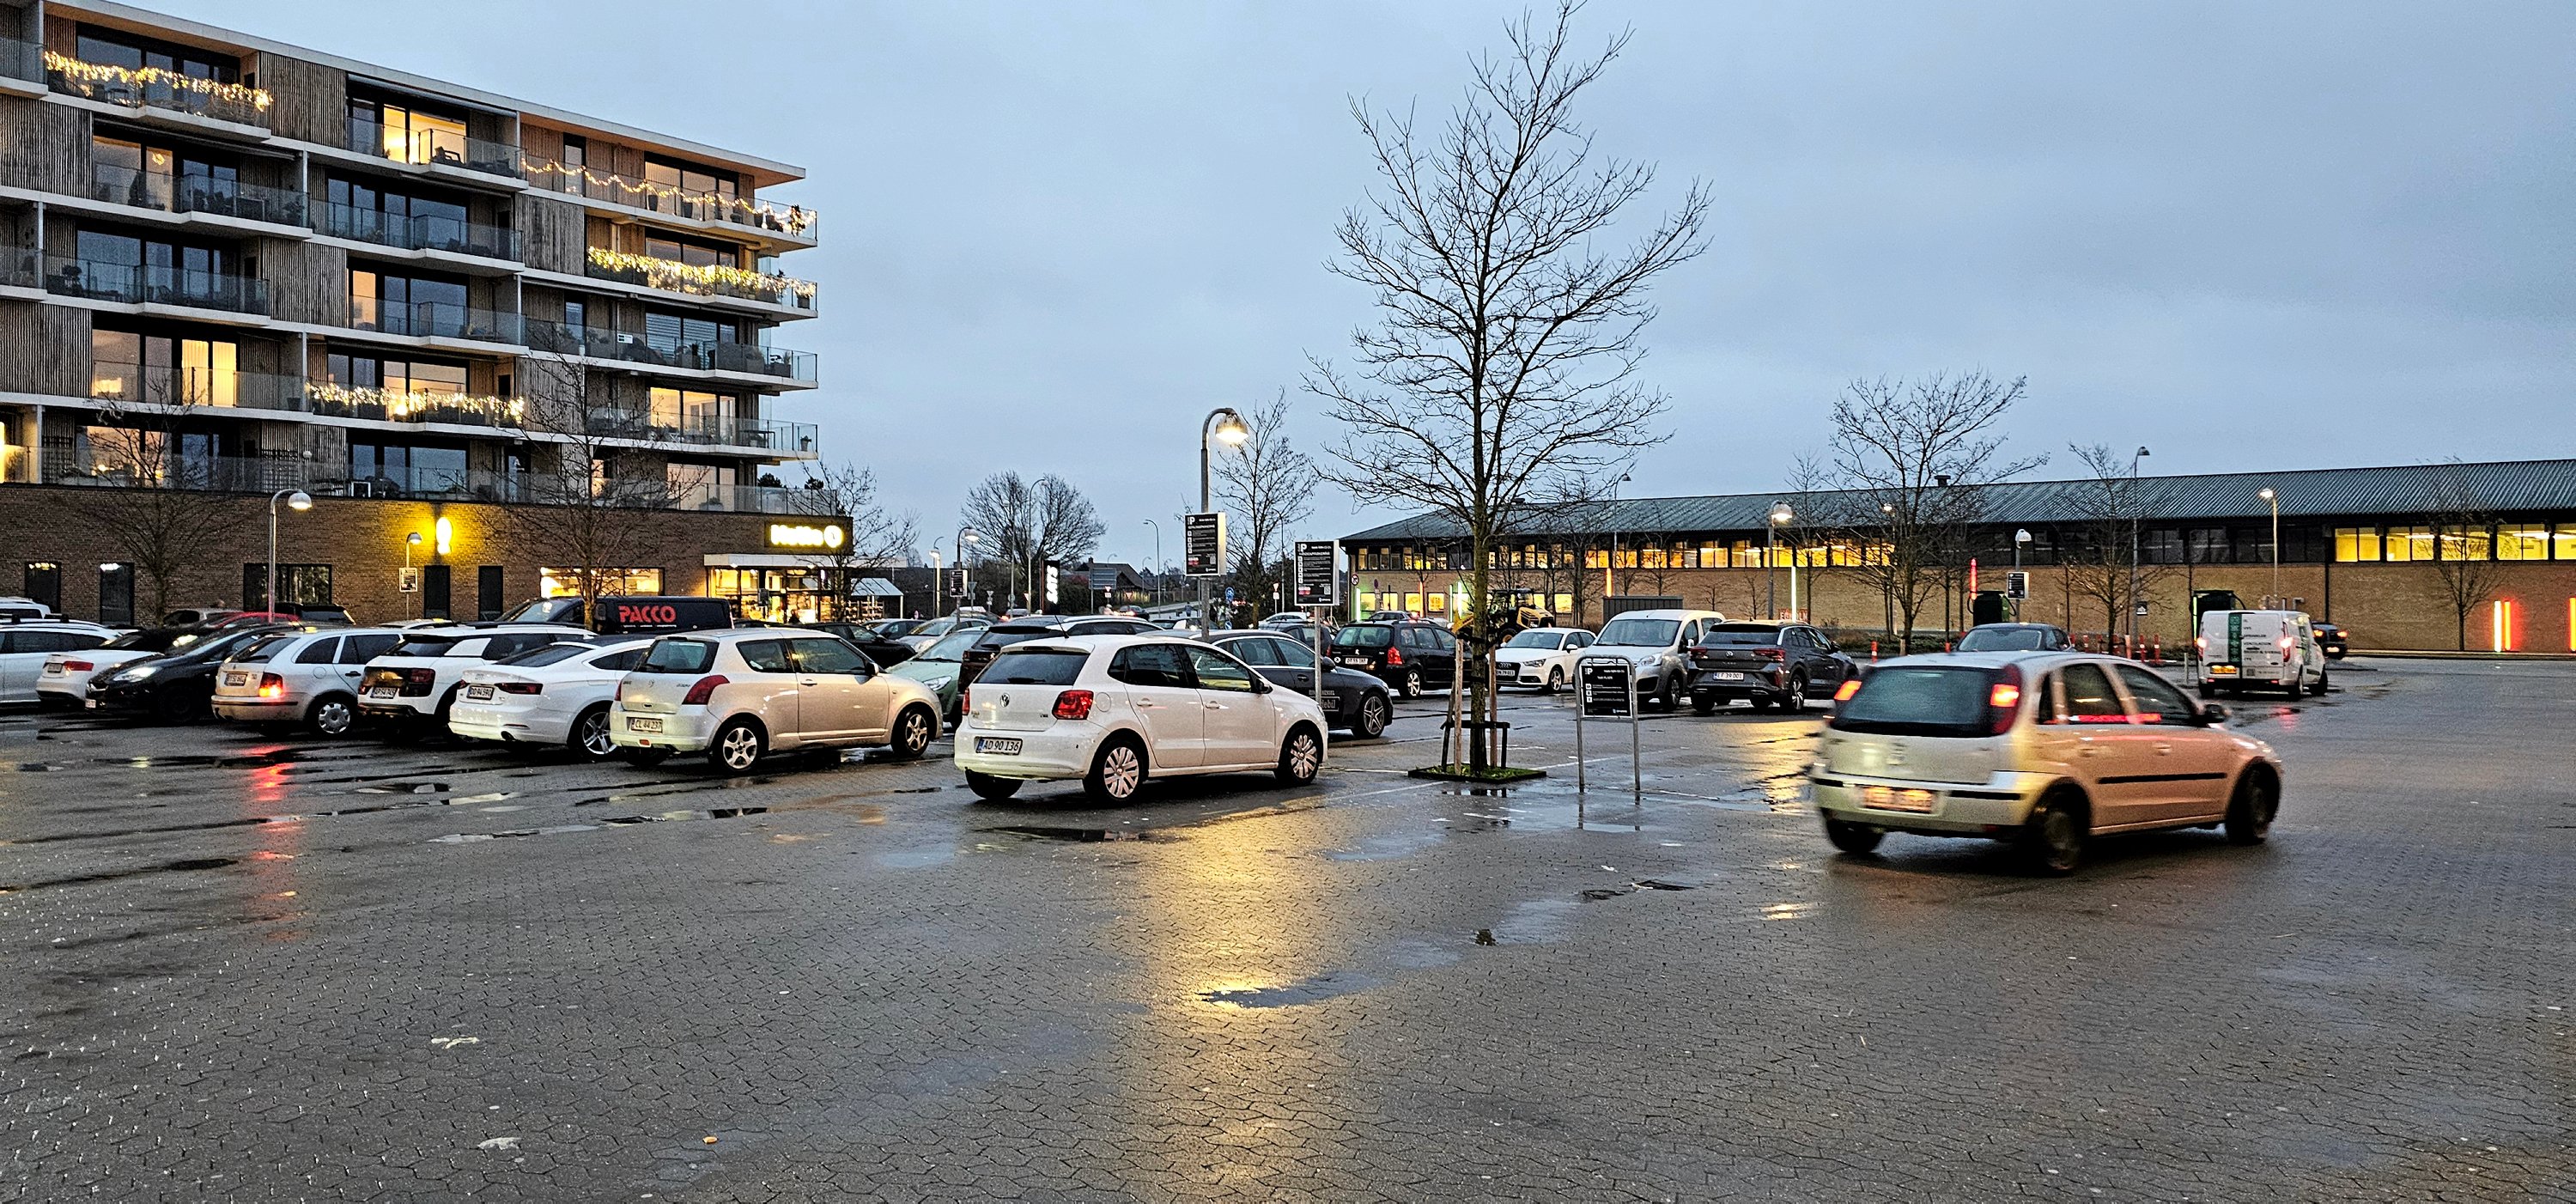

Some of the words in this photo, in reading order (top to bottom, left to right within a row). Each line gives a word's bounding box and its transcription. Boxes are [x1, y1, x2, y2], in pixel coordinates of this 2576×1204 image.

[1301, 544, 1307, 552] P
[618, 605, 676, 623] PACCO
[635, 720, 641, 728] CL
[651, 721, 662, 730] 237
[983, 739, 993, 750] AD
[995, 740, 1005, 751] 90
[1005, 741, 1019, 751] 136
